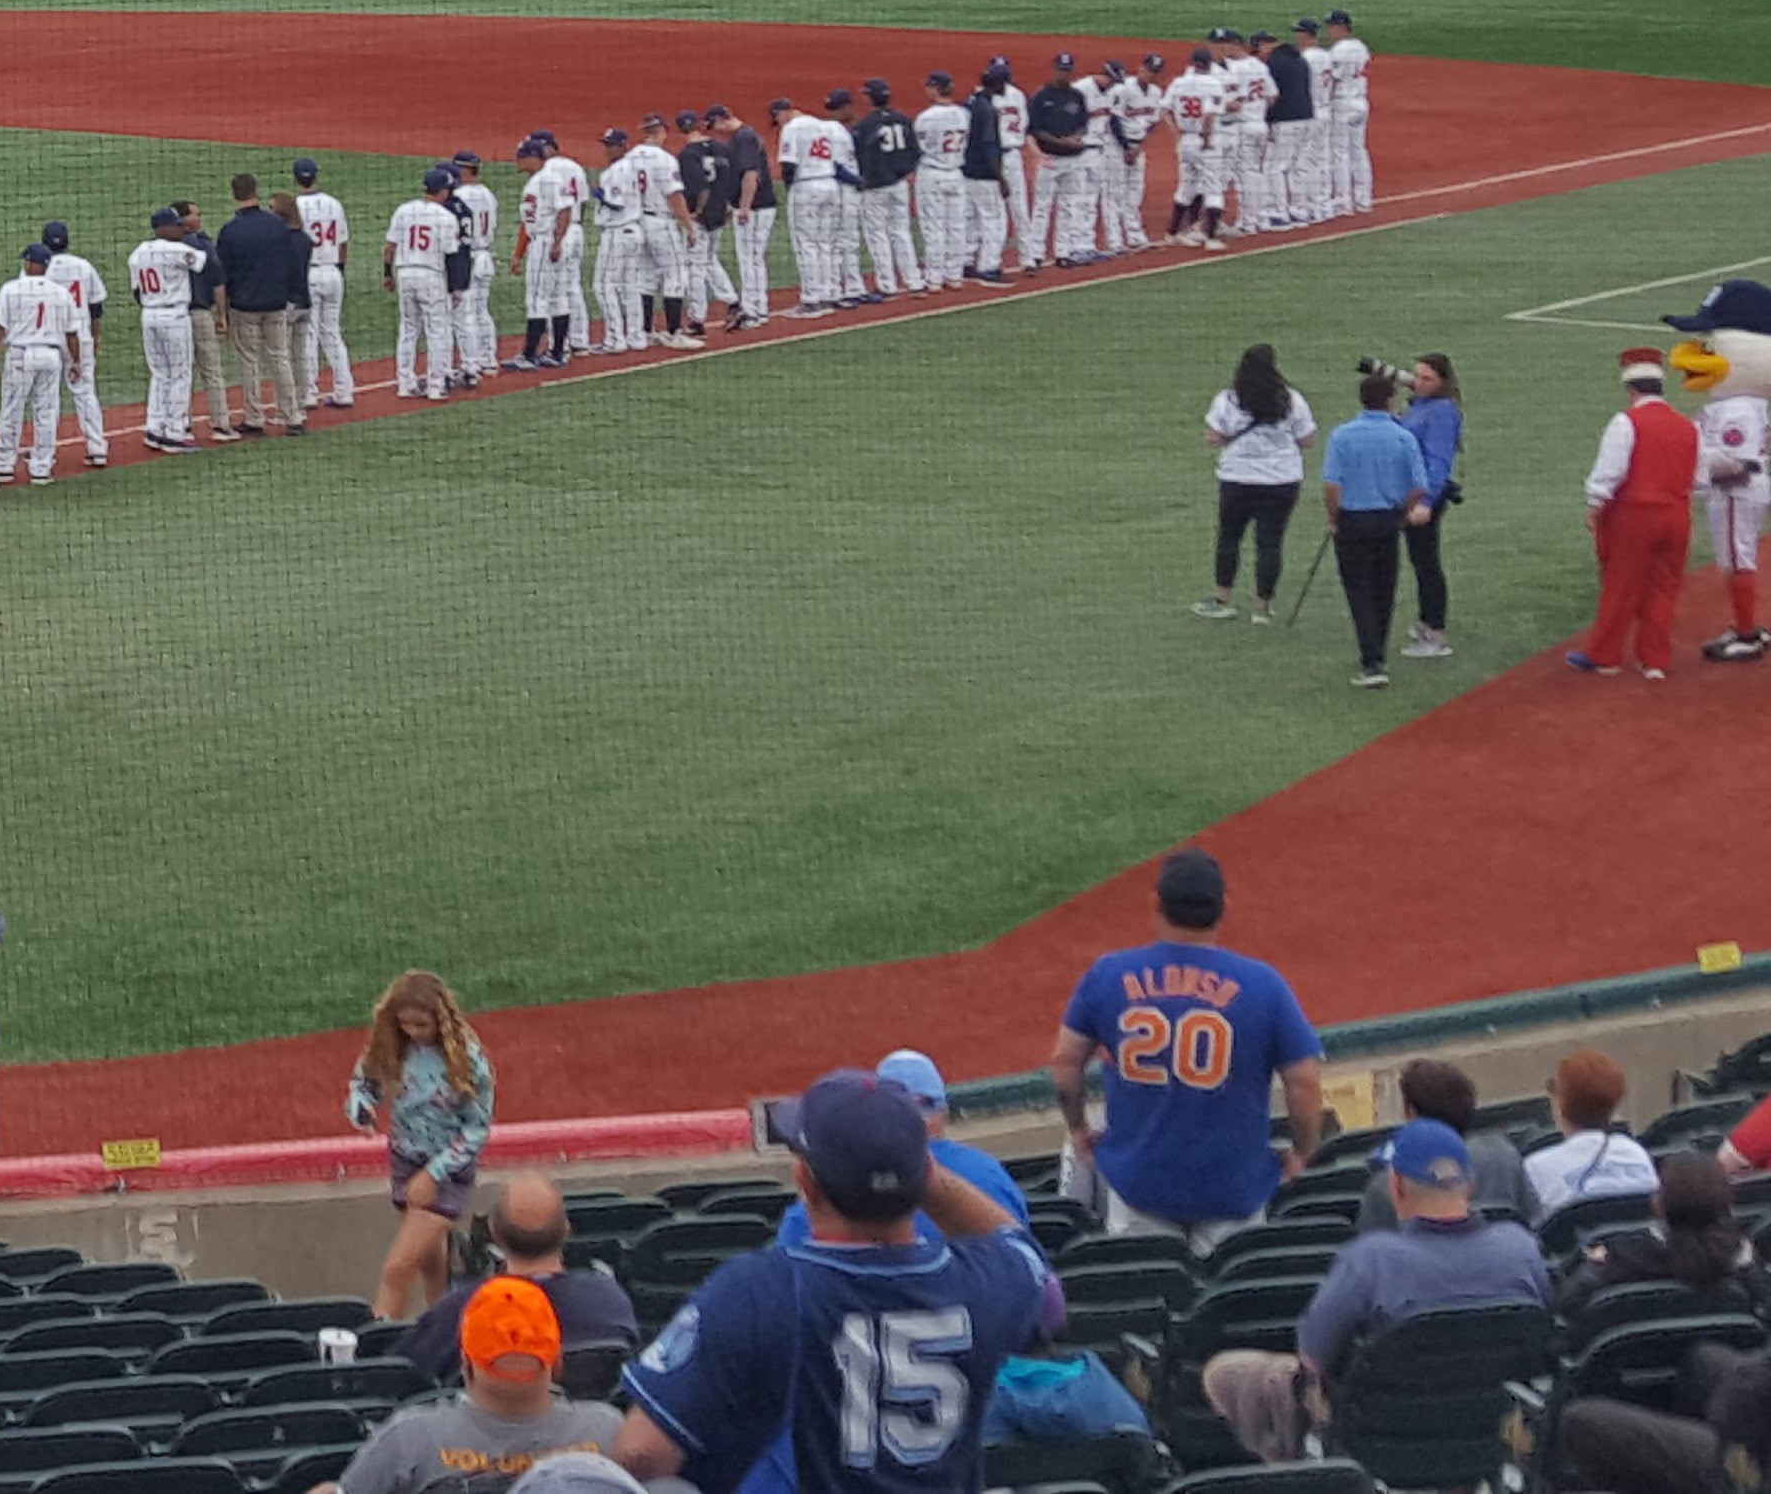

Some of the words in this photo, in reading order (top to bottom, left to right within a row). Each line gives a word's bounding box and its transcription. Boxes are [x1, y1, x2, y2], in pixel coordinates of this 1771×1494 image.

[877, 123, 907, 152] 31
[311, 219, 338, 248] 34
[408, 224, 432, 252] 15
[138, 268, 161, 295] 10
[35, 302, 45, 330] 1
[1122, 963, 1242, 1008] ALONSO
[1118, 1006, 1235, 1091] 20
[831, 1304, 974, 1471] 15
